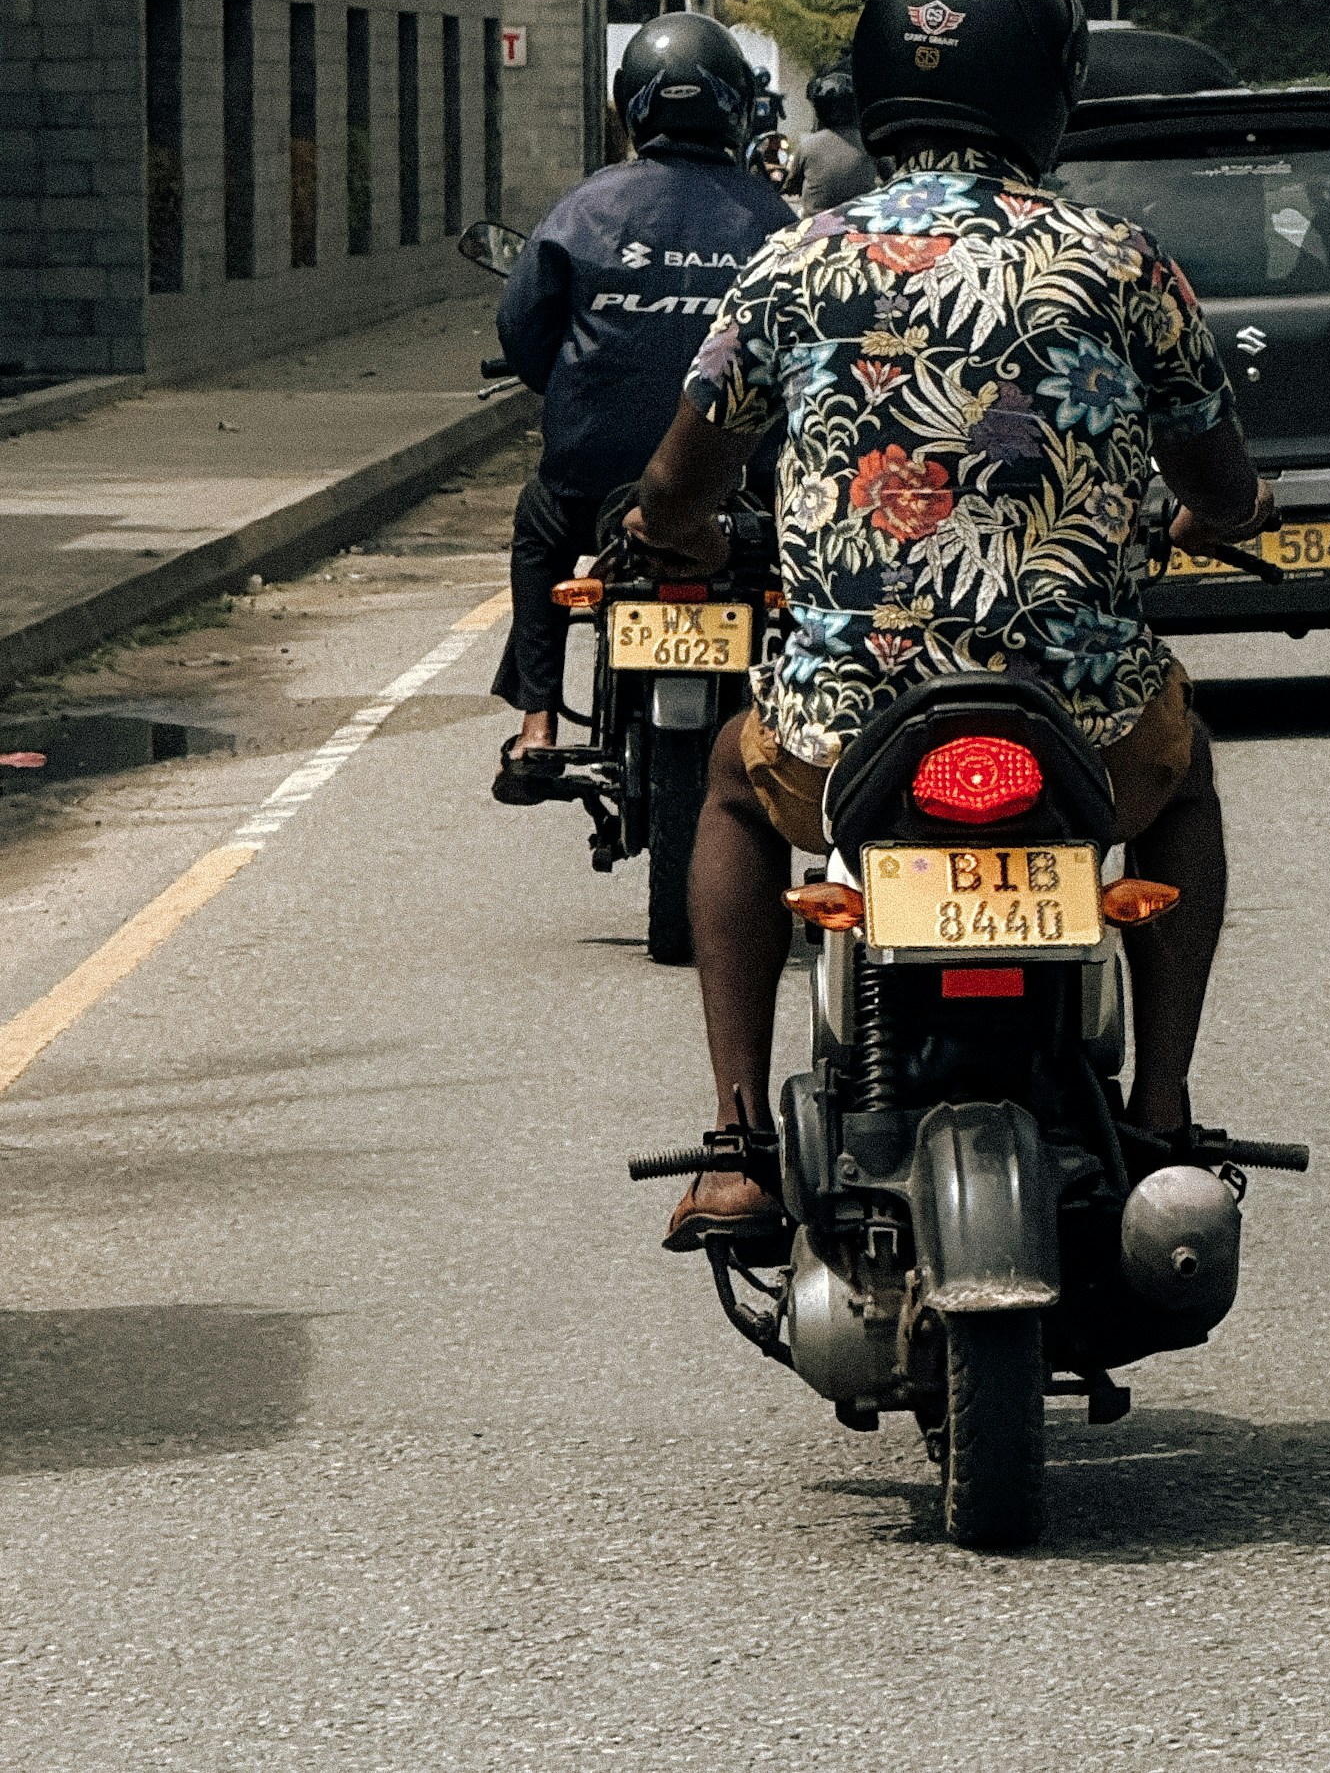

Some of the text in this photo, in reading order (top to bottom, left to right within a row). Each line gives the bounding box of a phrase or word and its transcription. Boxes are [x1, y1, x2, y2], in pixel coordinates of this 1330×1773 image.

[664, 250, 747, 270] BAJA
[661, 605, 706, 636] WX
[619, 625, 653, 647] SP
[654, 637, 730, 666] 6023
[948, 850, 1061, 893] BIB
[938, 898, 1064, 943] 8440
